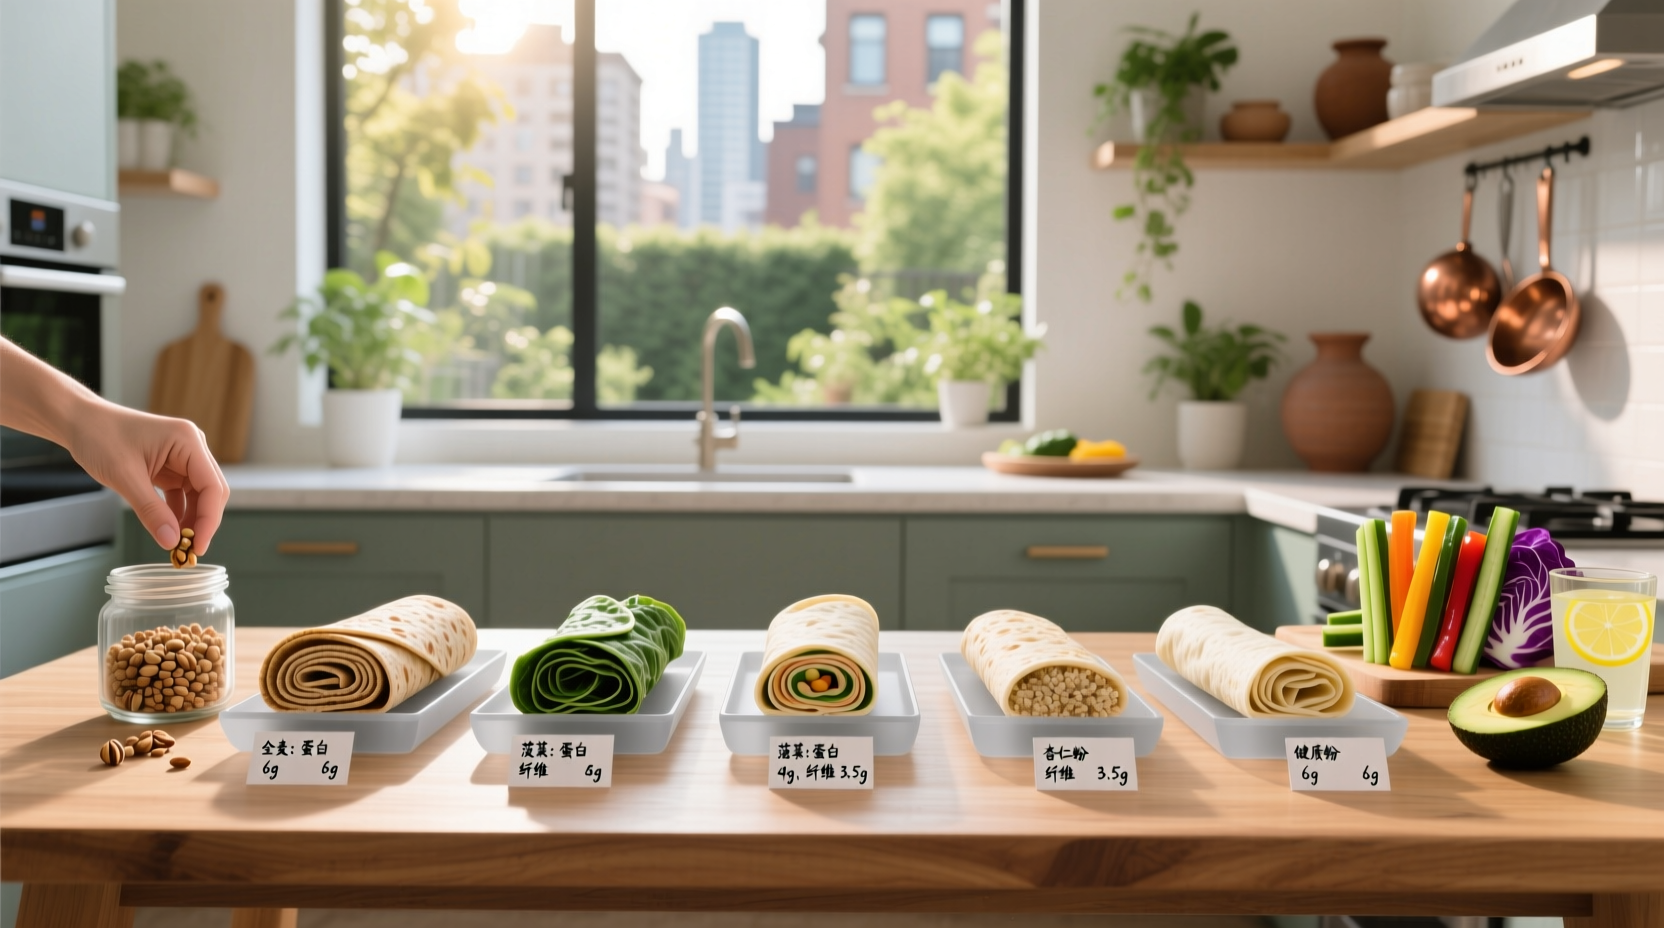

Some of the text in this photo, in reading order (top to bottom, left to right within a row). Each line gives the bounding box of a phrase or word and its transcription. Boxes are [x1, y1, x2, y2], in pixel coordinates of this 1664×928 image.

[262, 760, 339, 780] 6g 6g
[518, 762, 549, 779] 纤维
[840, 765, 868, 785] 3.5g
[1045, 764, 1129, 787] 纤维 3.5g
[1301, 765, 1379, 786] 6g 6g
